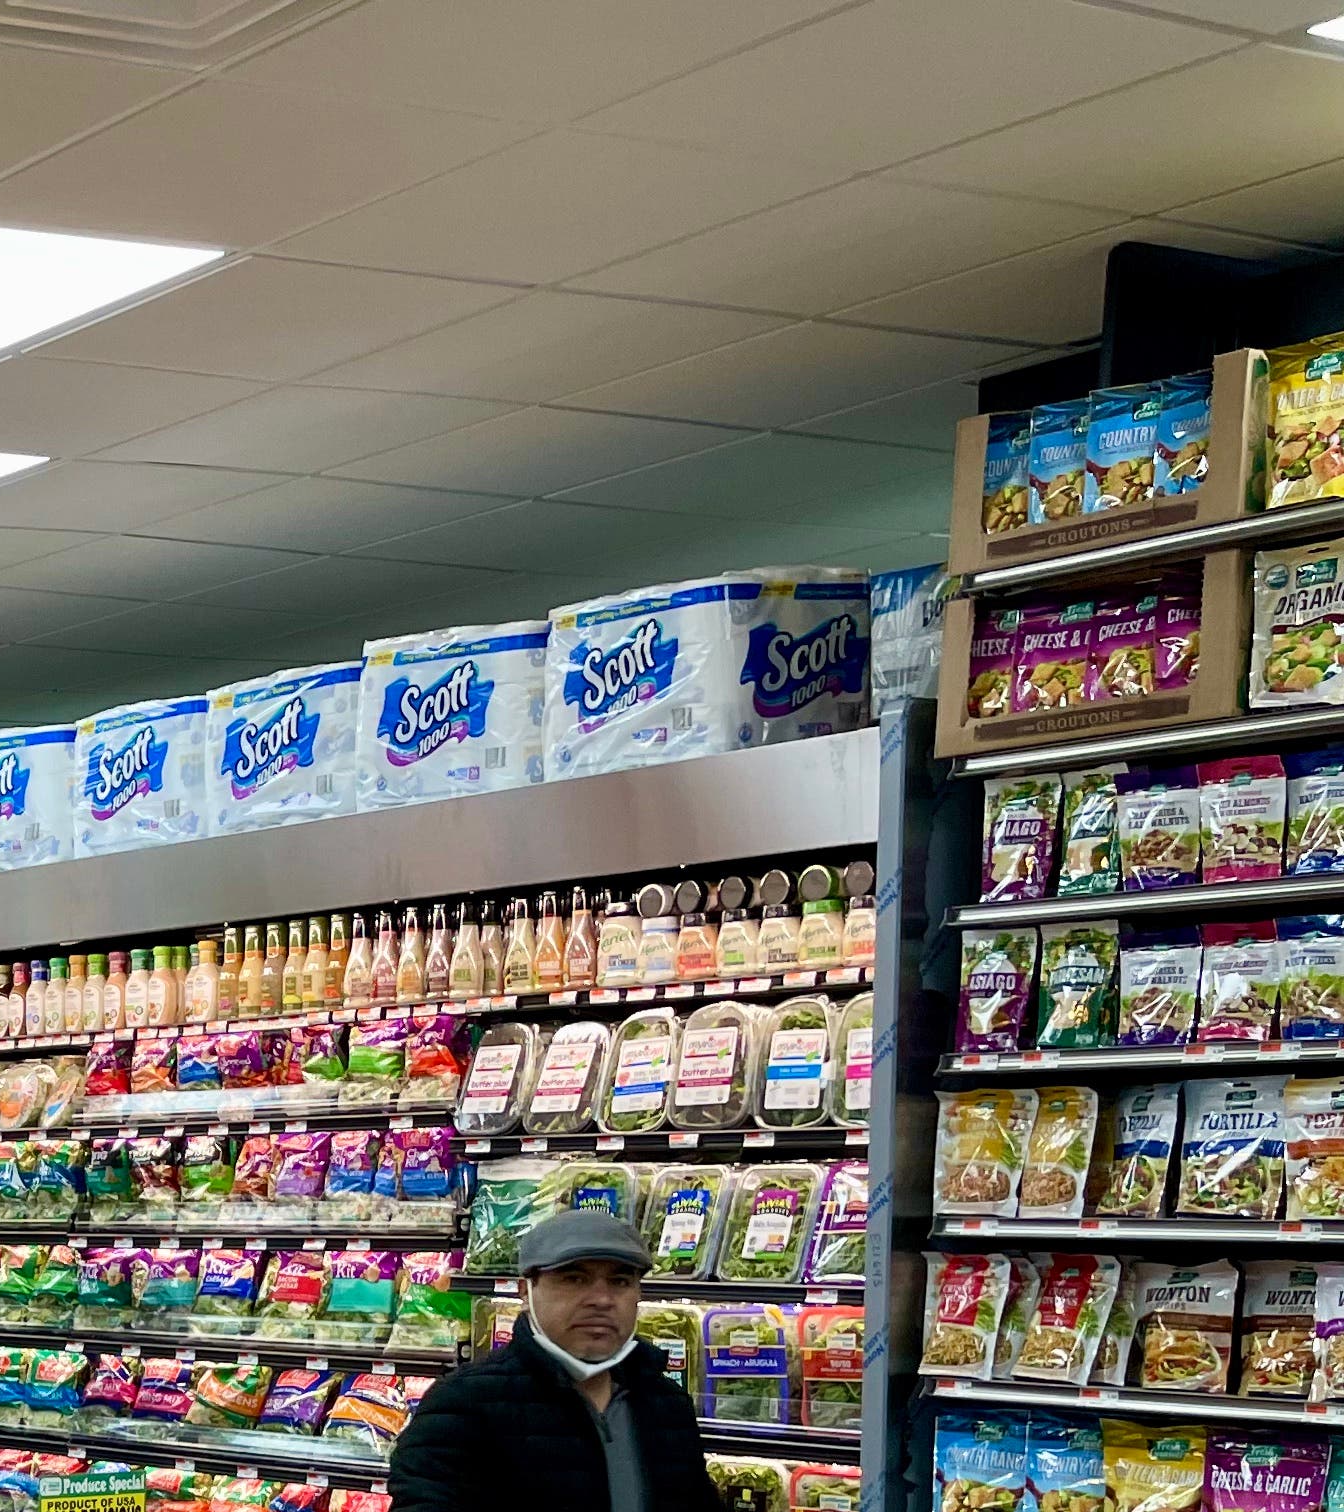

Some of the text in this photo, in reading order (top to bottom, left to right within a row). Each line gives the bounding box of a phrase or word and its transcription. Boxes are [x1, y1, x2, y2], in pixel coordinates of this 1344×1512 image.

[1099, 425, 1157, 449] COUNTRY
[1048, 519, 1131, 546] CROUTONS
[1024, 631, 1080, 651] CHEESE &
[1099, 618, 1141, 642] CHEESE
[582, 617, 658, 711] Scott
[761, 614, 851, 693] Scott
[395, 662, 475, 743] Scott
[791, 675, 826, 708] 1000
[1036, 710, 1120, 732] CROUTONS
[236, 698, 302, 778] Scott
[418, 723, 450, 757] 1000
[96, 726, 153, 801] Scott
[256, 756, 284, 787] 1000
[112, 779, 137, 811] 1000
[1200, 1111, 1278, 1130] TORTILLA
[1145, 1286, 1211, 1303] WONTON
[63, 1473, 144, 1494] Produce Special
[1212, 1466, 1311, 1497] CHEESE GARLIC
[47, 1497, 135, 1510] PRODUCT OF USA
